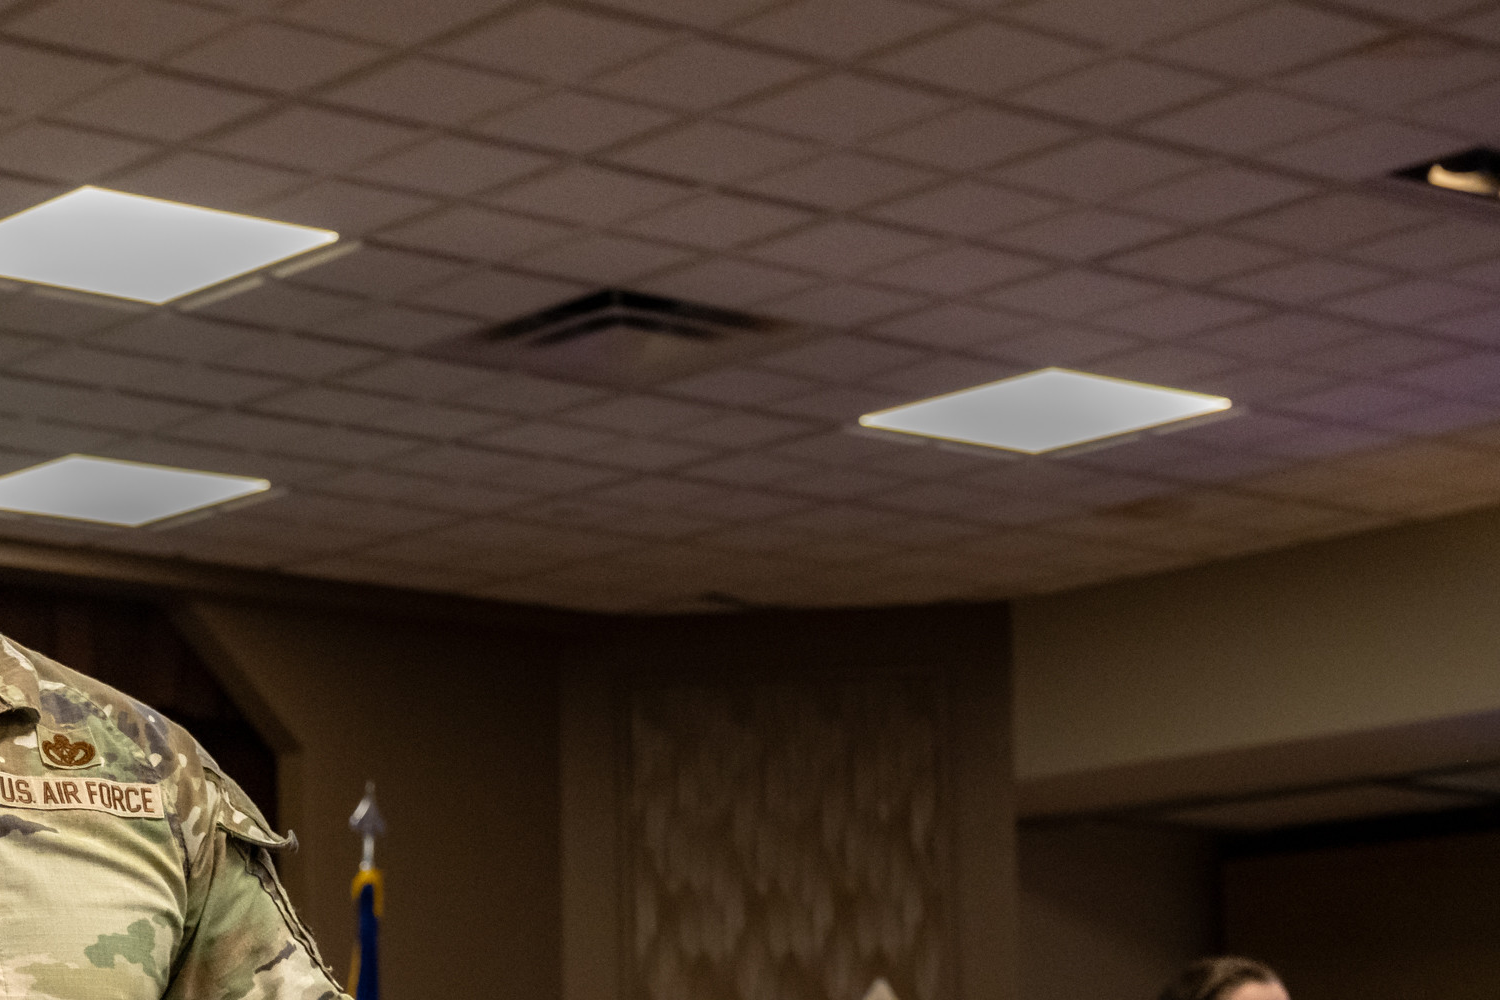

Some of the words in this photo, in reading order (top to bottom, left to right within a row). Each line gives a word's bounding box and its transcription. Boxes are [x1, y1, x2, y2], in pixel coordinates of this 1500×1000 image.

[0, 776, 36, 804] U.S.
[43, 780, 82, 805] AIR
[85, 781, 155, 813] FORCE
